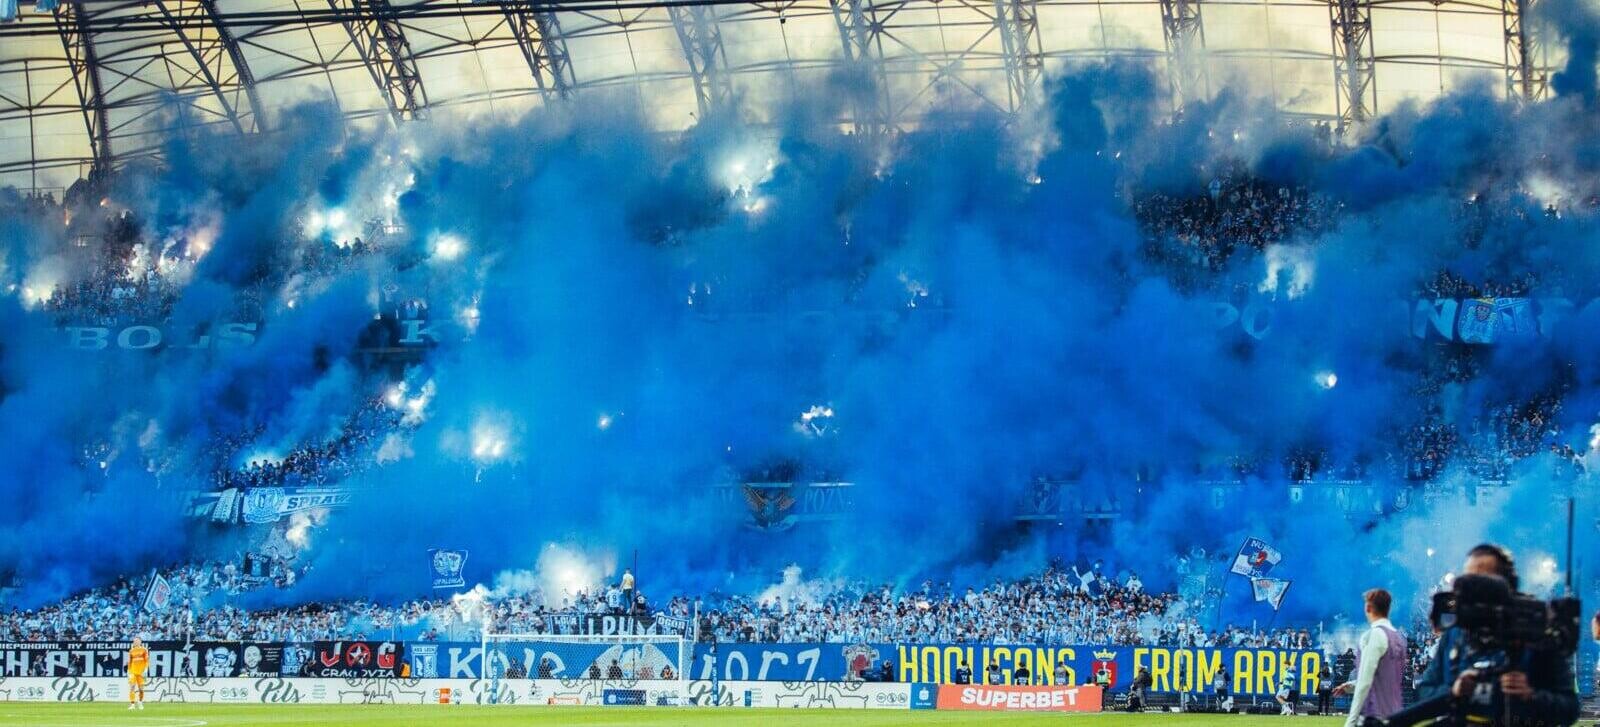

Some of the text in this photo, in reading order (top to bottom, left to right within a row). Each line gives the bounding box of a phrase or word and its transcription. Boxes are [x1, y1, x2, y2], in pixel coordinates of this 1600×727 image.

[899, 645, 1076, 686] HOOLIGANS
[1133, 648, 1222, 693] FROM
[51, 677, 100, 701] Pils
[255, 678, 306, 703] Pils
[469, 679, 522, 704] Pls
[689, 680, 741, 706] Pls
[961, 687, 1079, 708] SUPERBET
